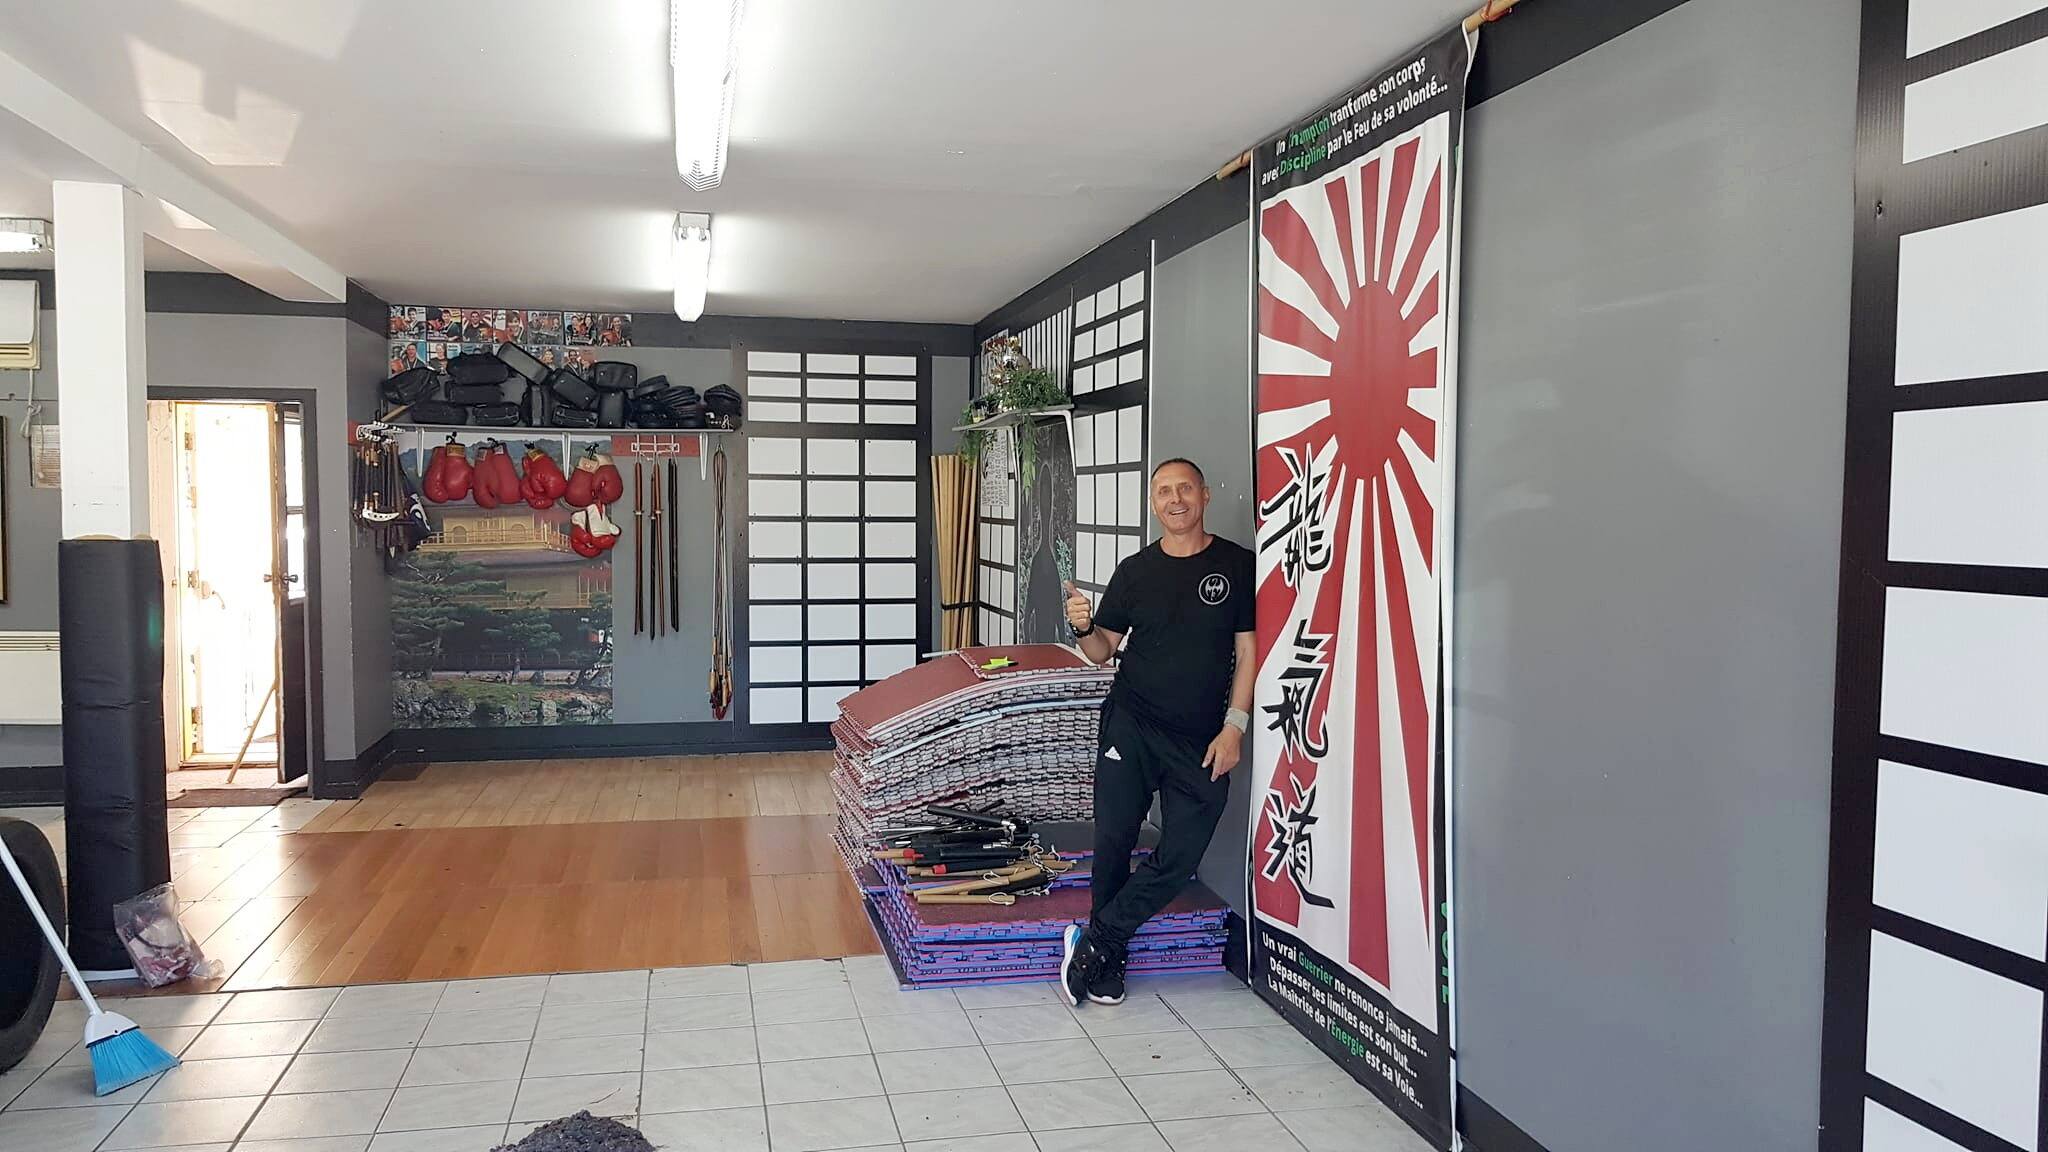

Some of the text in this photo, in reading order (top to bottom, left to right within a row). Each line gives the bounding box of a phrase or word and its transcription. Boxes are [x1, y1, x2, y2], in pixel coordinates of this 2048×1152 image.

[1280, 145, 1326, 175] Discipline
[1327, 137, 1343, 159] par
[1344, 126, 1353, 146] le
[1354, 119, 1370, 141] Feu
[1370, 112, 1383, 131] de
[1383, 104, 1395, 122] sa
[1288, 116, 1329, 149] hampion
[1379, 78, 1395, 98] son
[1396, 57, 1426, 86] corps
[1262, 932, 1275, 950] Un
[1277, 941, 1296, 961] vrai
[1299, 952, 1333, 985] Guerrier
[1334, 978, 1346, 995] ne
[1347, 988, 1385, 1024] renonce
[1270, 957, 1311, 992] Dépasser
[1312, 985, 1325, 1004] ses
[1327, 995, 1358, 1026] limites
[1359, 1020, 1373, 1041] est
[1375, 1032, 1392, 1054] son
[1267, 974, 1278, 994] La
[1279, 983, 1314, 1019] Maîtrise
[1315, 1007, 1325, 1026] de
[1365, 1051, 1381, 1072] est
[1382, 1064, 1393, 1082] sa
